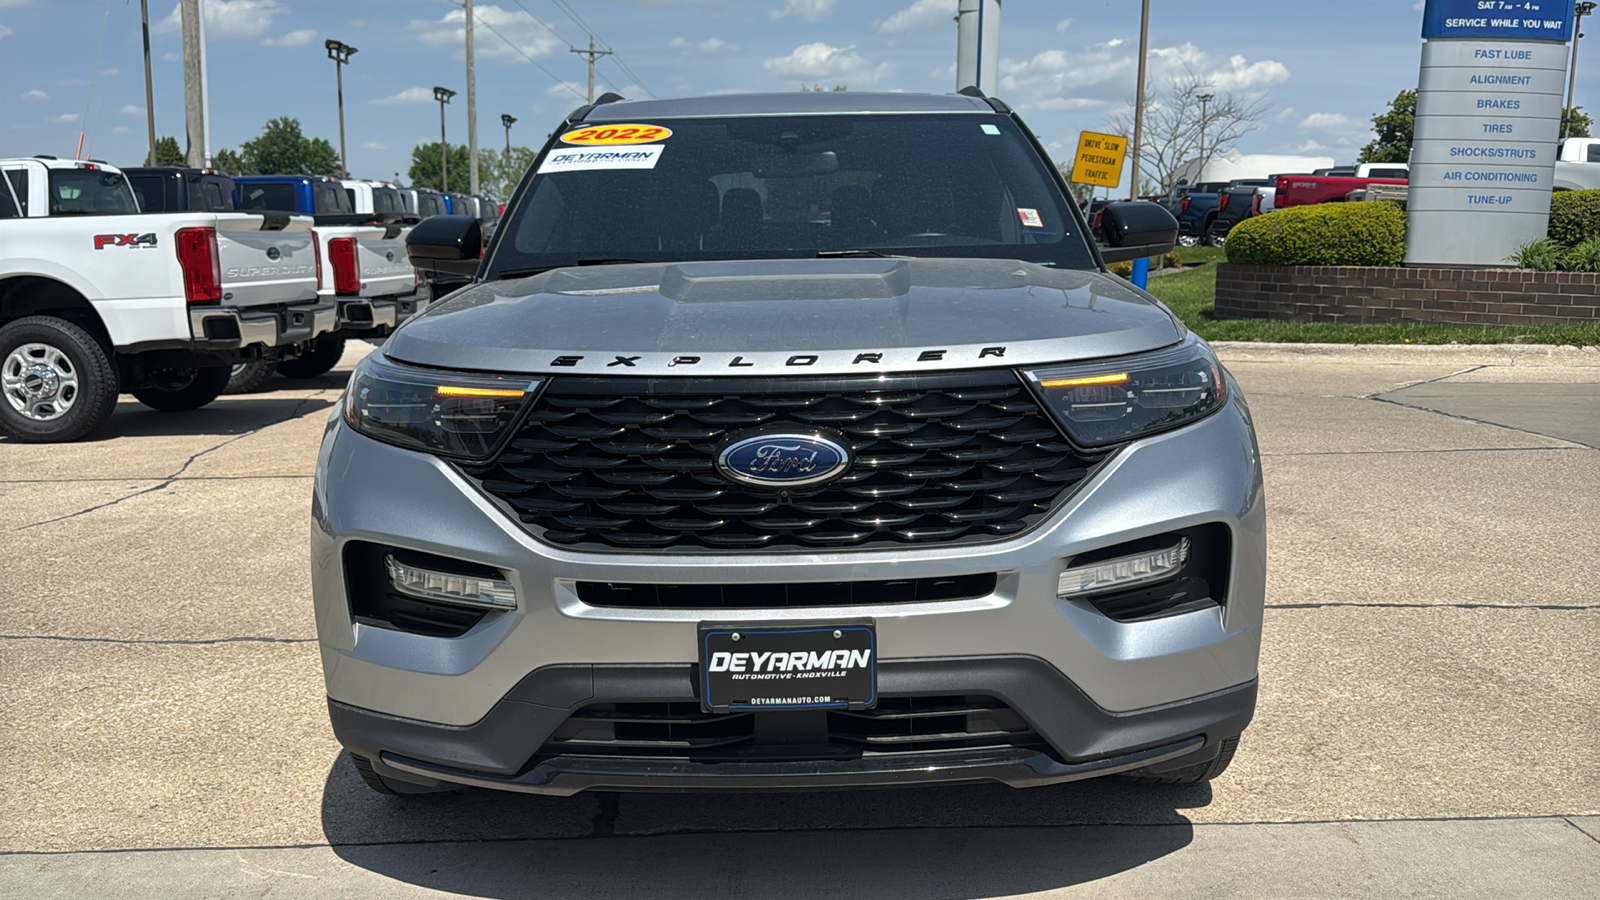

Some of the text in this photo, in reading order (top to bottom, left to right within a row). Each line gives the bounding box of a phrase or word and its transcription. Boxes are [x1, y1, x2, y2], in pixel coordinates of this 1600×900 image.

[1477, 1, 1496, 10] SAT
[1445, 18, 1563, 30] SERVICE WHILE YOU WAIT
[1474, 49, 1532, 60] FAST LUBE
[1469, 75, 1532, 85] ALIGNMENT
[1477, 99, 1520, 110] BRAKES
[1482, 124, 1513, 133] TIRES
[570, 128, 663, 141] 2022
[1084, 139, 1119, 151] DRIVE SLOW
[552, 152, 654, 163] DEYARMAN
[1450, 148, 1536, 159] SHOCKS/STRUTS
[1081, 153, 1116, 166] PEDESTRIAN
[1085, 169, 1109, 180] TRAFFIC
[1443, 173, 1538, 183] AIR CONDITIONING
[1468, 195, 1512, 205] TUNE-UP
[94, 232, 158, 250] FX4
[227, 265, 314, 278] SUPER DUTY
[550, 346, 1007, 367] EXPLORER
[749, 444, 818, 473] Ford
[709, 649, 871, 672] DEYARMAN
[751, 695, 831, 705] DEYARMANAUTO.COM
